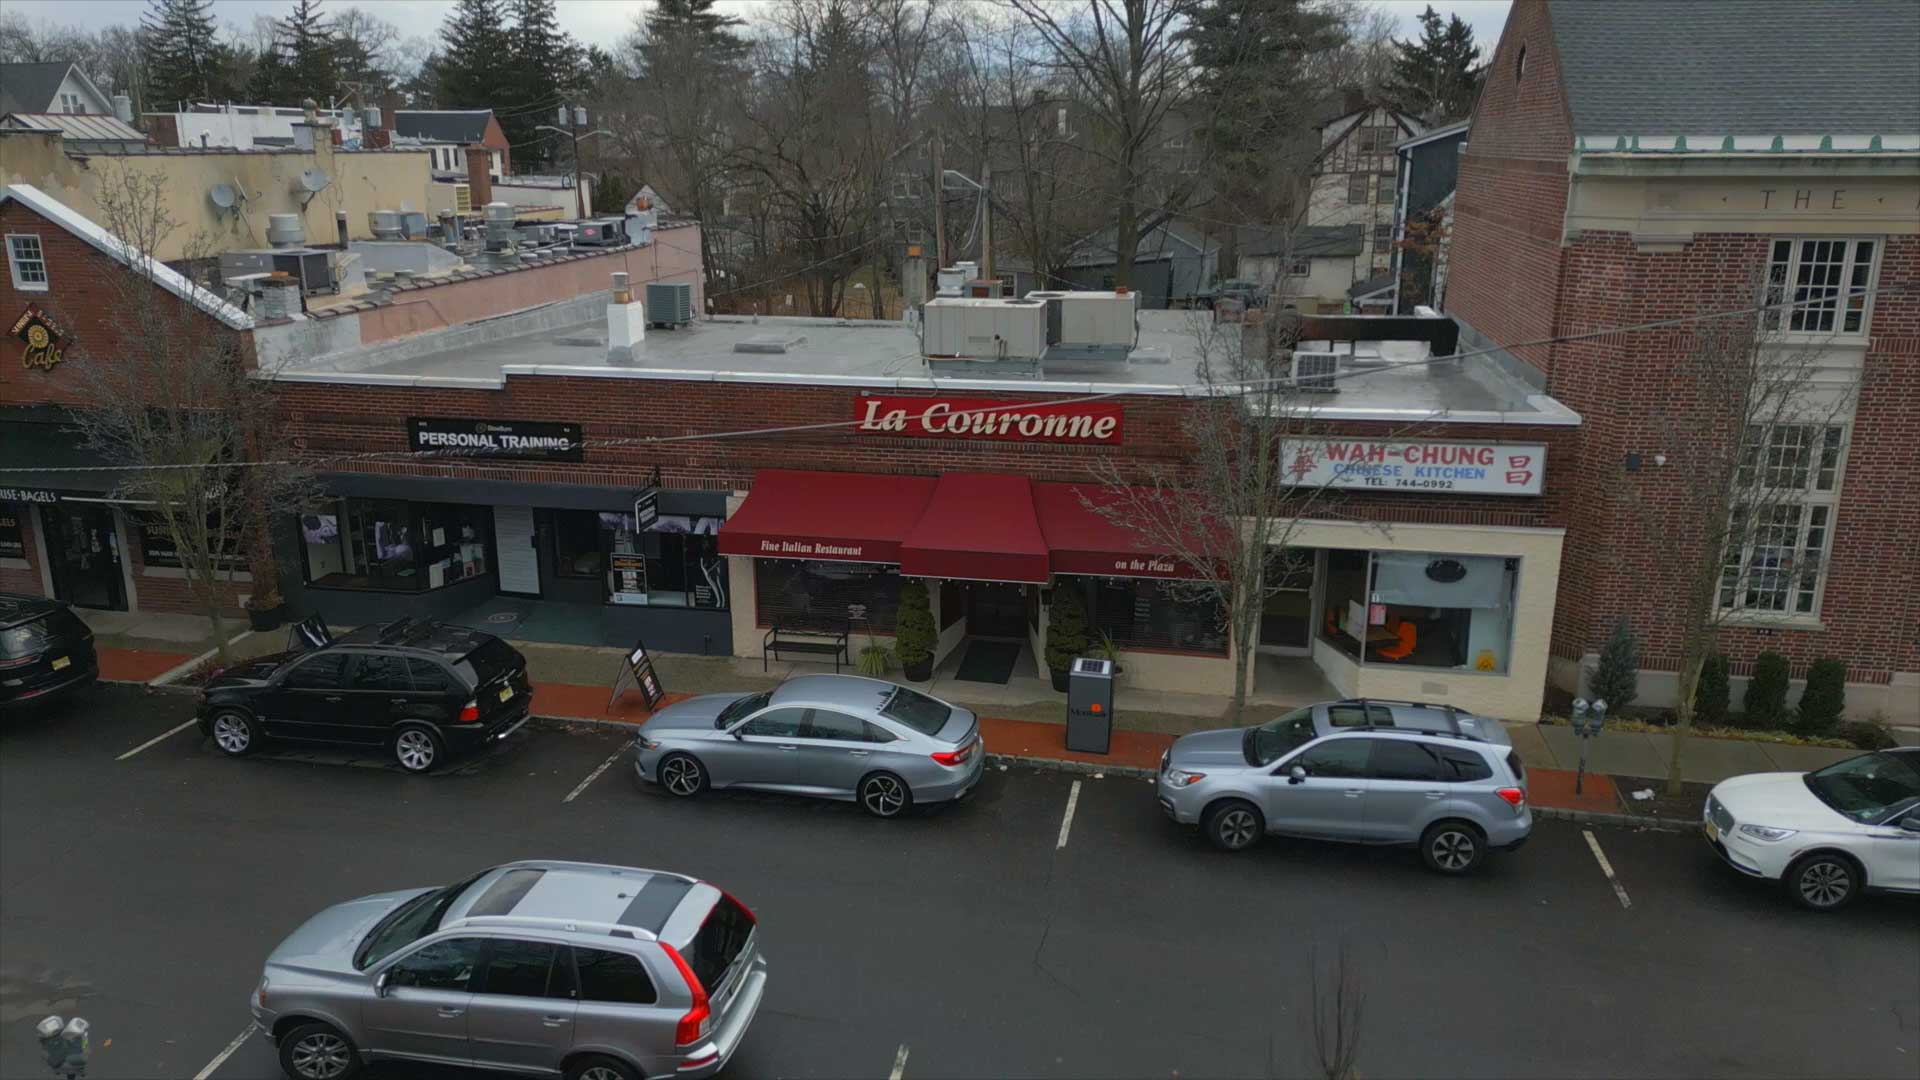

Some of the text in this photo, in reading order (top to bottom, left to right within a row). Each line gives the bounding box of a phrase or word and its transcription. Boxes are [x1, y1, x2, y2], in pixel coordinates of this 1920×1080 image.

[1760, 189, 1847, 210] THE
[22, 343, 63, 370] Cafe
[859, 400, 1117, 439] La Couronne
[419, 432, 570, 451] PERSONAL TRAINING
[1326, 442, 1495, 466] WAH-CHUNG
[1332, 463, 1486, 479] CHINESE KITCHEN
[1505, 455, 1533, 486] 昌
[1364, 477, 1453, 489] TEL: 744-0992
[760, 540, 862, 556] Fine Italian Restaurant
[1114, 559, 1175, 573] on the Plaza
